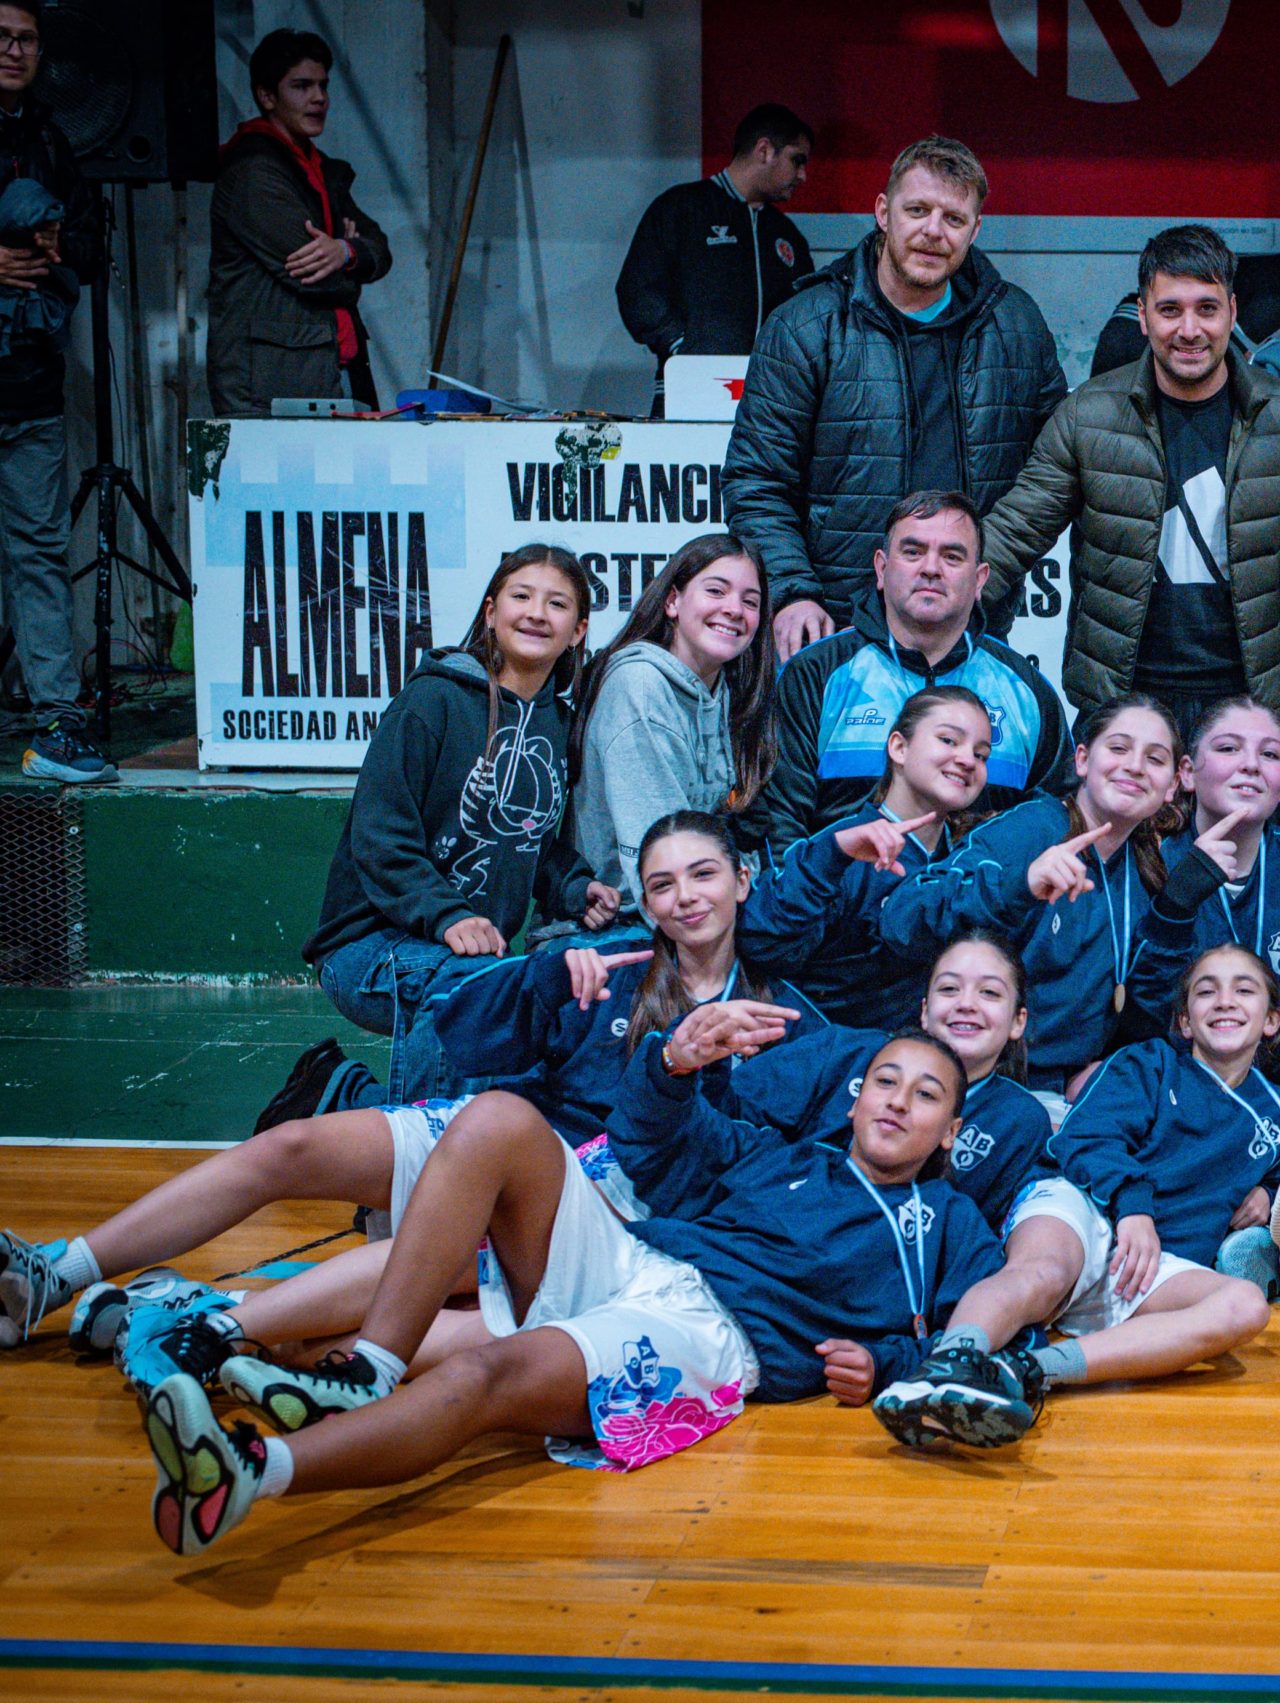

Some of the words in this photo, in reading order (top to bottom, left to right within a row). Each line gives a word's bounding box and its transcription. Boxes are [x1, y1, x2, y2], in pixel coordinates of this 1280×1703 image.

[506, 462, 727, 523] VIGILANCI
[242, 510, 434, 698] ALMENA
[222, 709, 337, 741] SOCIEDAD
[345, 711, 386, 741] AN
